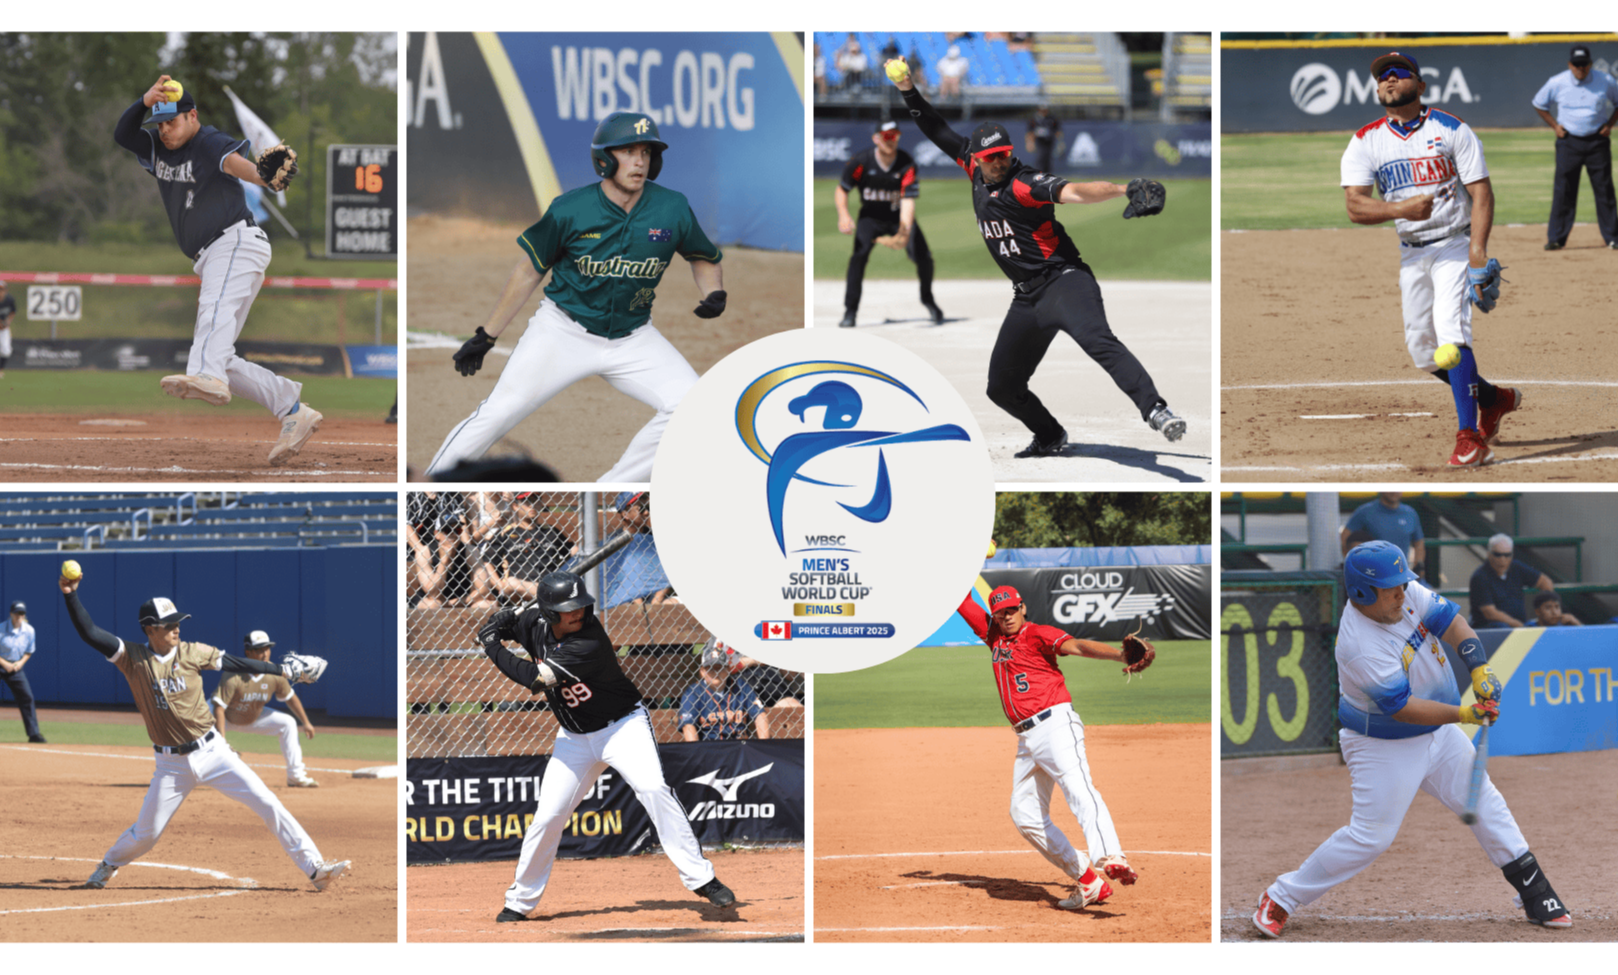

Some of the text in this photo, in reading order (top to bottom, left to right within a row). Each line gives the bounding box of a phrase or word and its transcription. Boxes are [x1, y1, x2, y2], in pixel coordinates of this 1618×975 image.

[551, 46, 755, 131] WBSC.ORG
[1343, 67, 1473, 105] MGA
[355, 166, 383, 193] 16
[335, 207, 392, 229] GUEST
[336, 231, 391, 253] HOME
[1000, 238, 1021, 257] 44
[31, 290, 80, 315] 250
[1060, 572, 1123, 590] CLOUD
[991, 591, 1012, 606] USA
[1053, 591, 1126, 626] GFX
[1014, 672, 1030, 693] 5
[1221, 601, 1310, 745] 03
[240, 692, 268, 703] JAPAN
[561, 682, 592, 708] 99
[1529, 669, 1585, 706] FOR
[422, 778, 481, 805] THE
[488, 776, 541, 803] TITL
[687, 800, 775, 821] MIZUNO
[1543, 898, 1562, 912] 22
